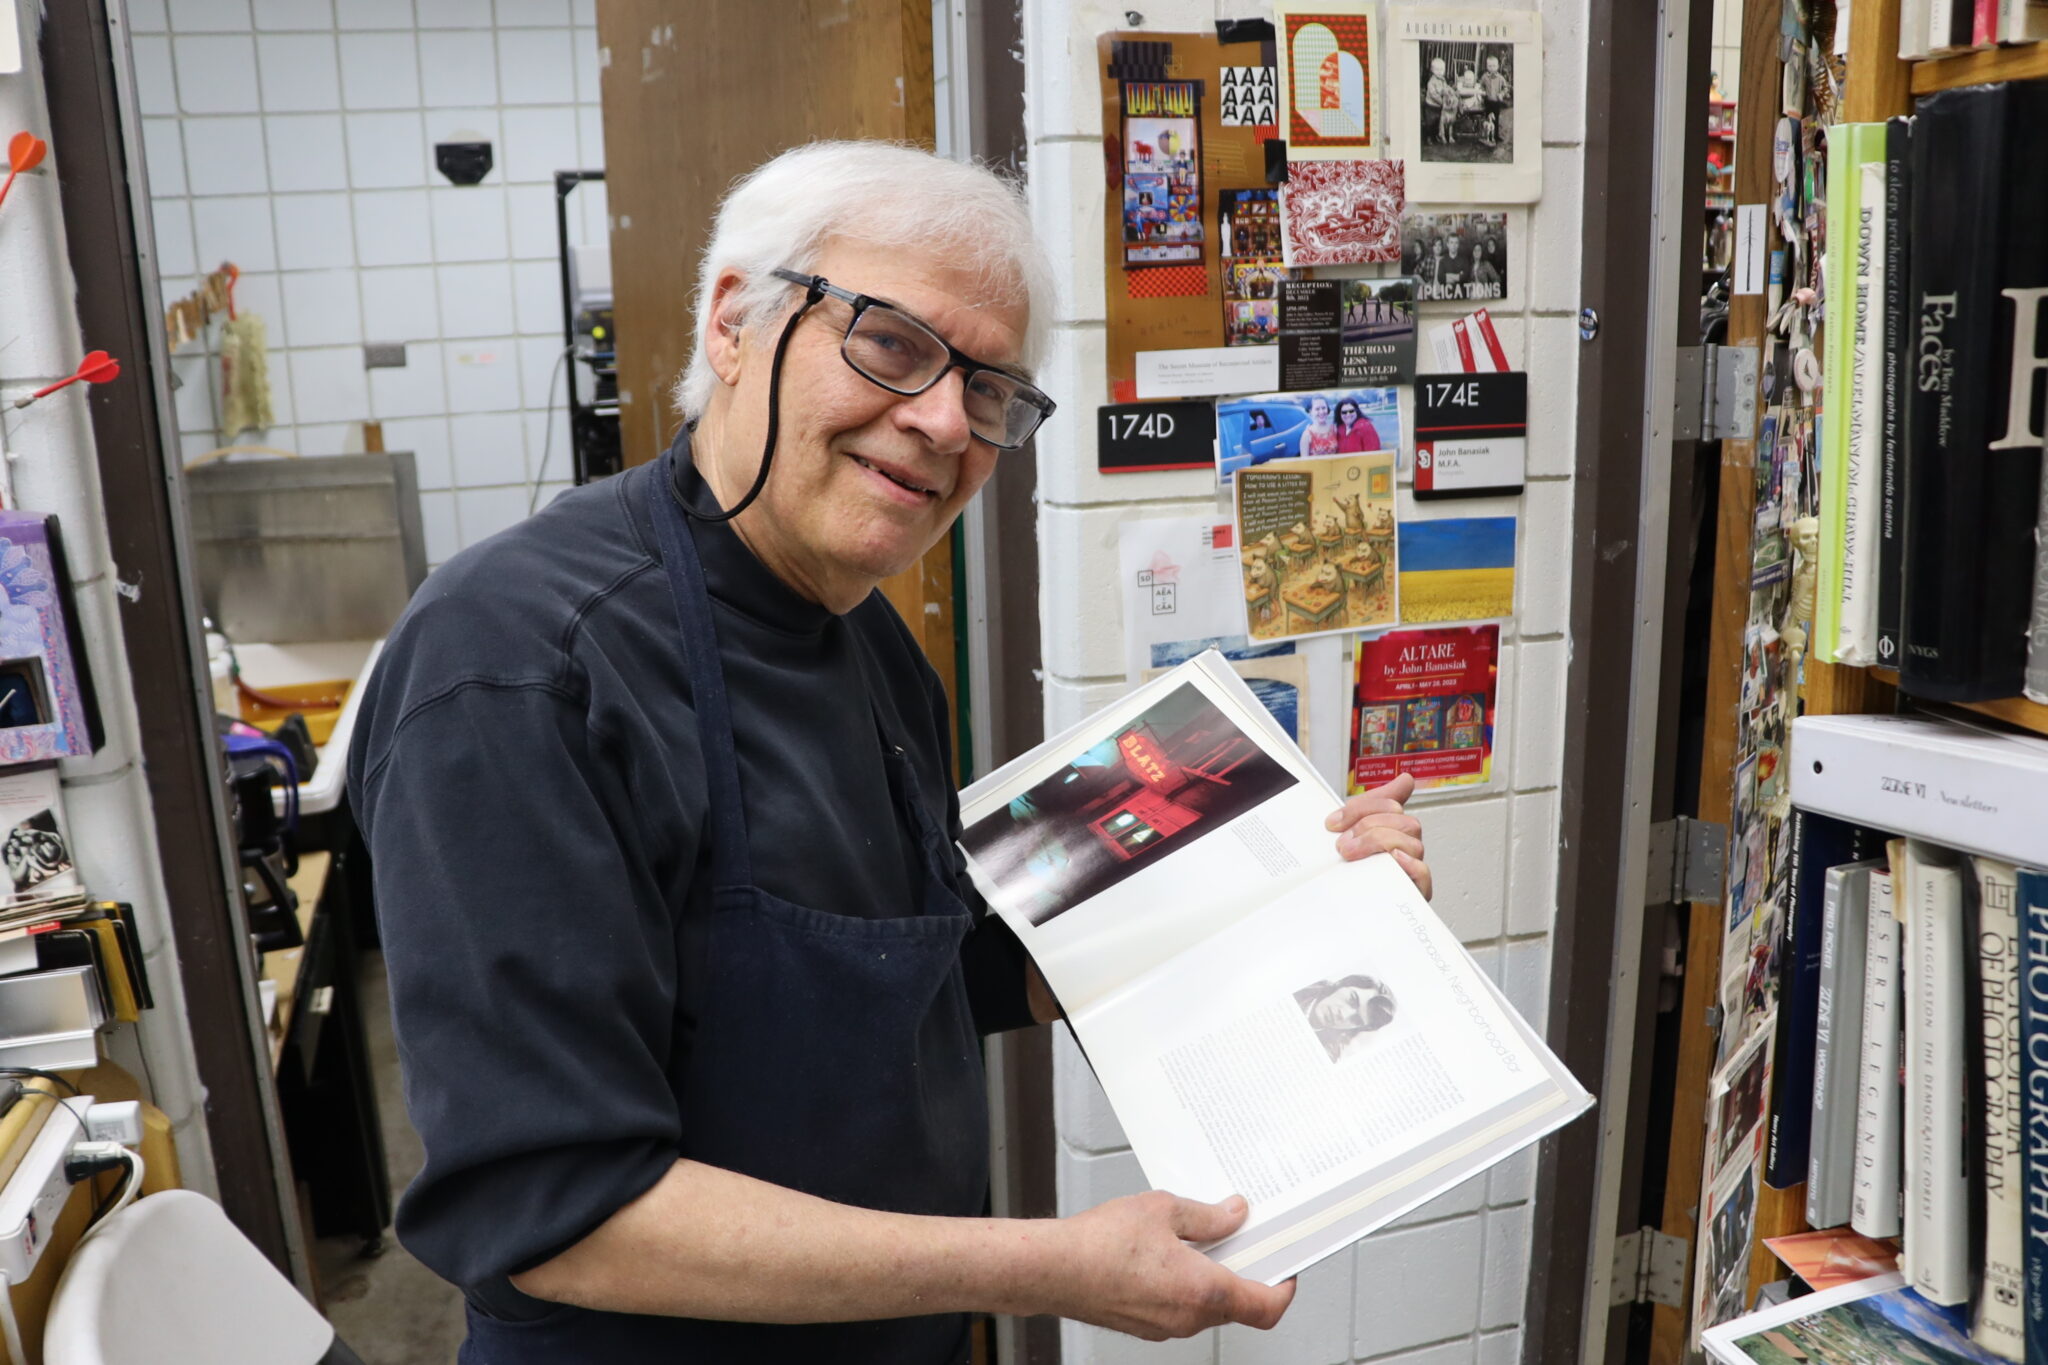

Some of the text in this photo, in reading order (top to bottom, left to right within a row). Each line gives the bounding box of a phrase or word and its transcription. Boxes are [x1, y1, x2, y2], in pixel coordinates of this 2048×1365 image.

[1406, 23, 1452, 35] AUGUST
[1890, 158, 1900, 173] to
[1858, 206, 1873, 277] DOWN
[1887, 218, 1902, 287] perchance
[1887, 290, 1898, 303] to
[1887, 304, 1900, 349] dream
[1342, 345, 1395, 355] THE ROAD
[1919, 291, 1958, 392] Faces
[1342, 357, 1367, 366] LESS
[1342, 366, 1397, 376] TRAVELED
[1425, 382, 1479, 407] 174E
[1885, 351, 1898, 420] photographs
[1938, 349, 1955, 448] by Ben Maddow
[1108, 412, 1174, 440] 174D
[1885, 422, 1897, 437] by
[1438, 446, 1490, 457] John Banasiak
[1438, 460, 1461, 468] M.F.A.
[1884, 439, 1896, 497] ferdinando
[1884, 498, 1895, 538] scianna
[1399, 643, 1456, 662] ALTARE
[1384, 659, 1467, 677] by John Banasiak
[1122, 735, 1165, 782] BLATZ
[1786, 896, 1797, 942] Photography
[1826, 901, 1835, 928] FRED
[1824, 935, 1836, 969] PICKER
[1862, 883, 1892, 1190] DESERT LEGENDS
[1922, 881, 1935, 1221] WILLIAM EGGLESTON THE DEMOCRATIC FOREST
[1815, 1048, 1827, 1111] WORKSHOP
[1981, 932, 2005, 1199] OF PHOTOGRAPHY
[1771, 1114, 1779, 1135] Henry
[1768, 1147, 1777, 1171] Gallery
